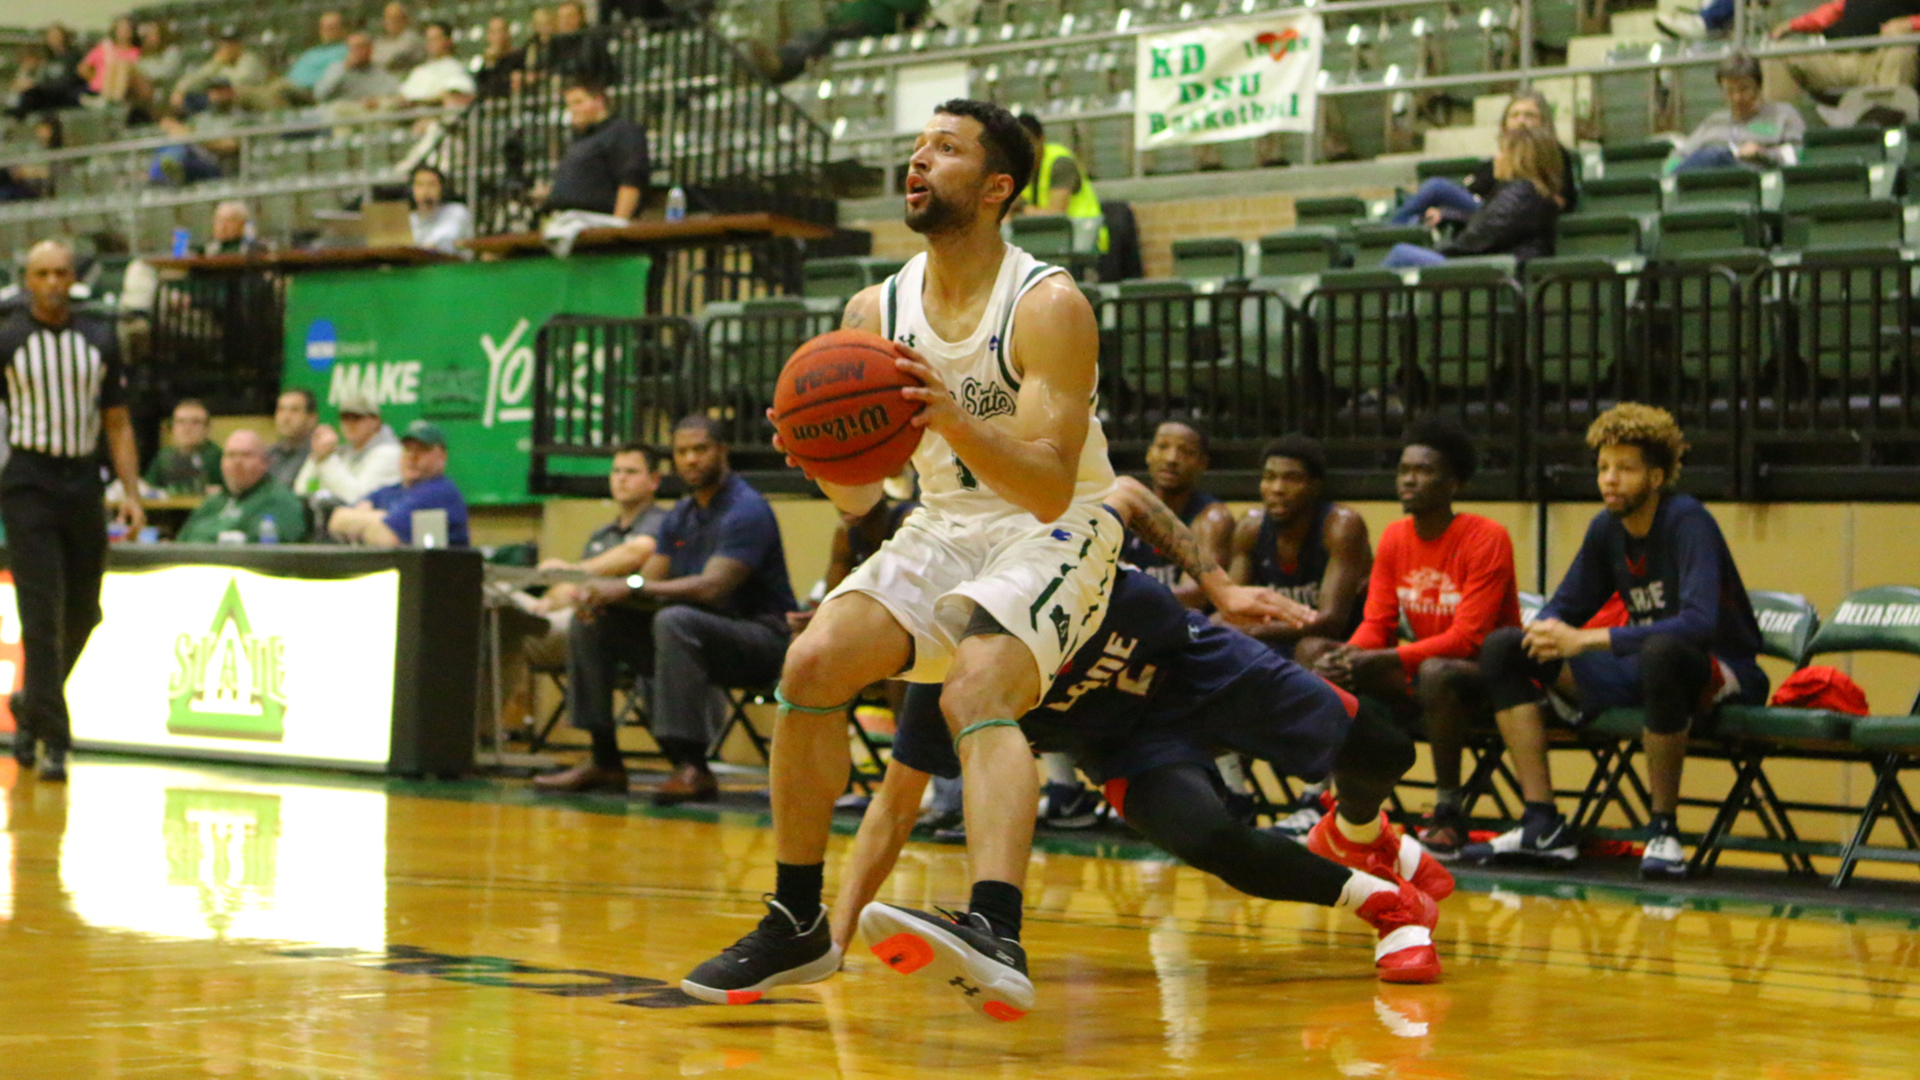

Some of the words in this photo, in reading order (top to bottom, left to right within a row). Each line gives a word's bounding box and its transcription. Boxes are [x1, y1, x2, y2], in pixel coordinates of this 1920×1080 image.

[1150, 44, 1206, 78] KD
[1180, 72, 1262, 104] DSU
[328, 361, 421, 405] MAKE
[961, 377, 1016, 421] Sate
[791, 404, 890, 442] Wilson
[1834, 601, 1884, 626] DELTA
[1881, 602, 1920, 627] STAT
